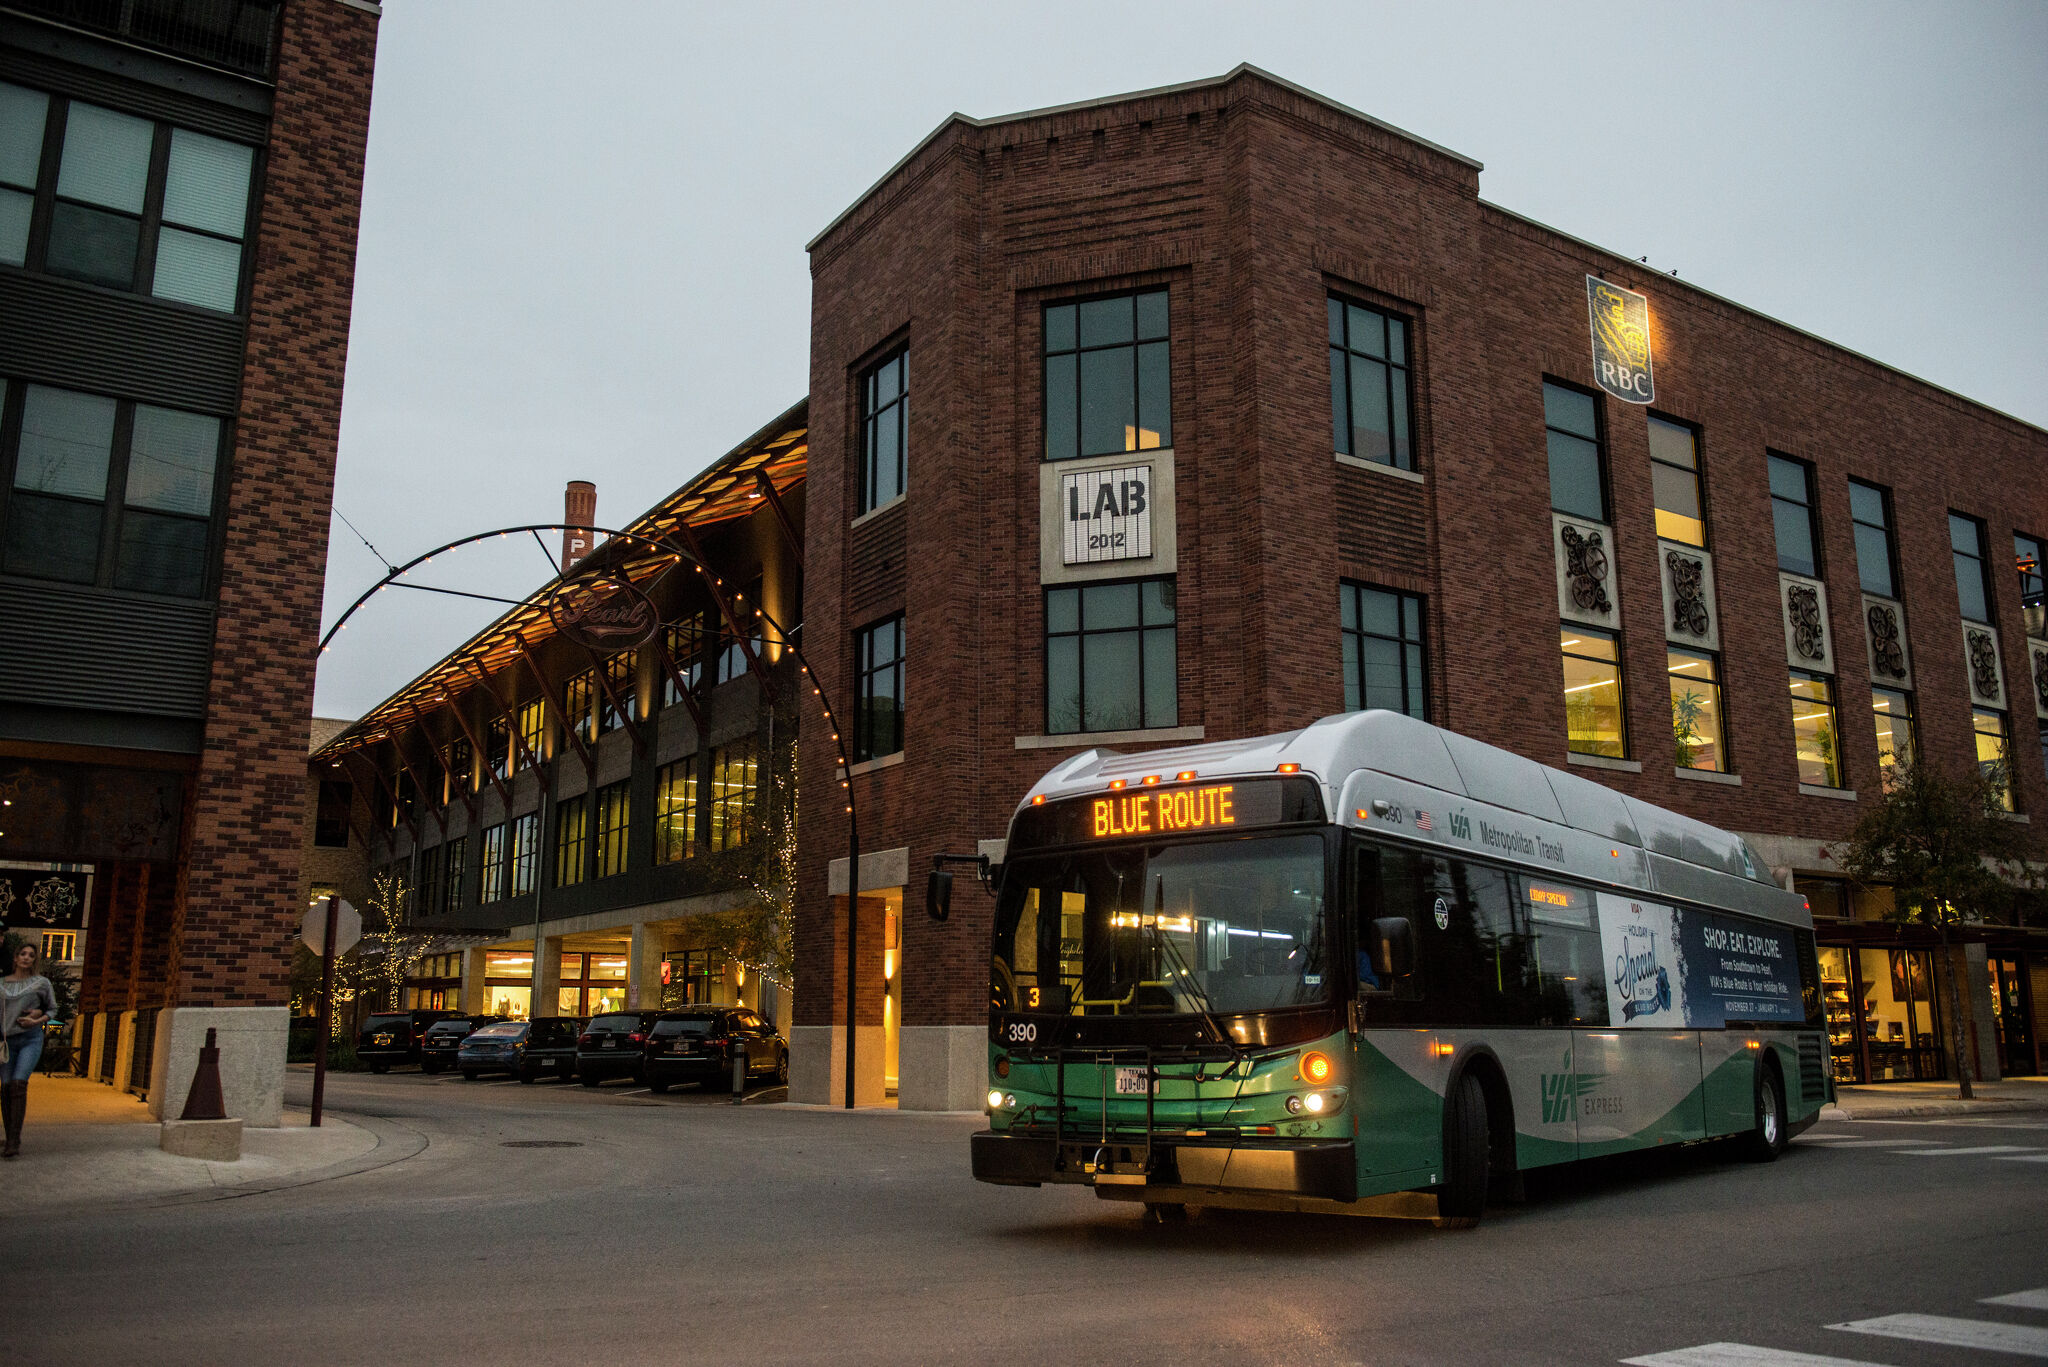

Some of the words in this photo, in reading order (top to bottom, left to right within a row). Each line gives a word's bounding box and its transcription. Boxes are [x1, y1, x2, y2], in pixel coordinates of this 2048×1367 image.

[1601, 360, 1648, 397] RBC
[1069, 480, 1146, 522] LAB
[1089, 532, 1125, 550] 2012
[560, 588, 648, 626] Pearl
[1093, 795, 1151, 836] BLUE
[1158, 785, 1235, 830] ROUTE
[1448, 807, 1472, 841] VIA
[1480, 820, 1535, 856] Metropolitan
[1536, 835, 1565, 863] Transit
[1628, 924, 1648, 937] HOLIDAY
[1703, 926, 1730, 951] SHOP.
[1729, 931, 1748, 954] EAT.
[1747, 934, 1782, 959] EXPLORE.
[1614, 931, 1659, 1001] Special
[1720, 958, 1733, 972] From
[1756, 962, 1761, 974] to
[1639, 987, 1645, 996] ON
[1645, 988, 1653, 997] THE
[1709, 975, 1723, 988] VIA's
[1723, 976, 1734, 989] Blue
[1734, 977, 1748, 991] Route
[1752, 979, 1763, 992] Your
[1763, 980, 1779, 996] Holiday
[1778, 981, 1789, 994] Ride.
[1029, 987, 1040, 1007] 3
[1725, 1001, 1748, 1012] NOVEMBER
[1757, 1003, 1775, 1014] JANUARY
[1008, 1023, 1037, 1042] 390
[1540, 1048, 1577, 1124] VIA
[1584, 1097, 1623, 1116] EXPRESS
